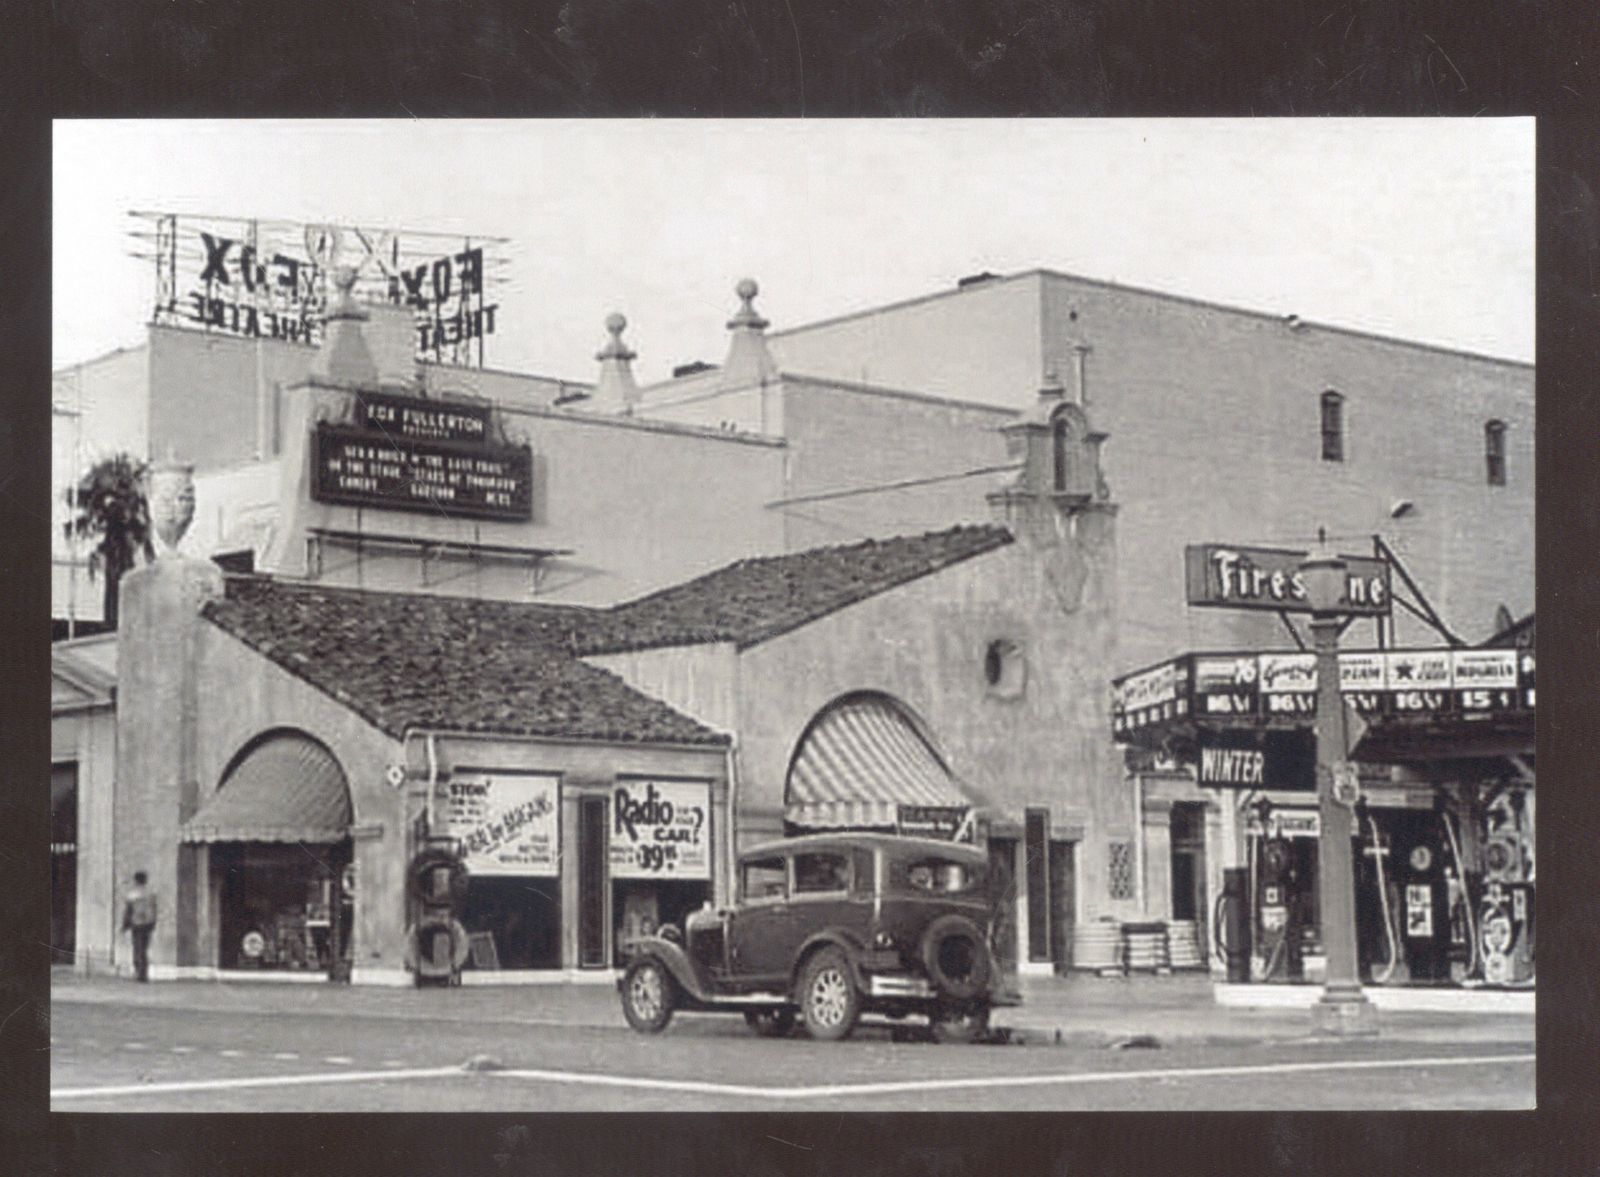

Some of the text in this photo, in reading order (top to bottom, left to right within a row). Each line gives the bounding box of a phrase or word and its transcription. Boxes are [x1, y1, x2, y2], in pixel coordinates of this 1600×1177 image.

[1213, 549, 1385, 605] Firesne
[1202, 748, 1265, 784] WINTER
[615, 783, 675, 842] Radio
